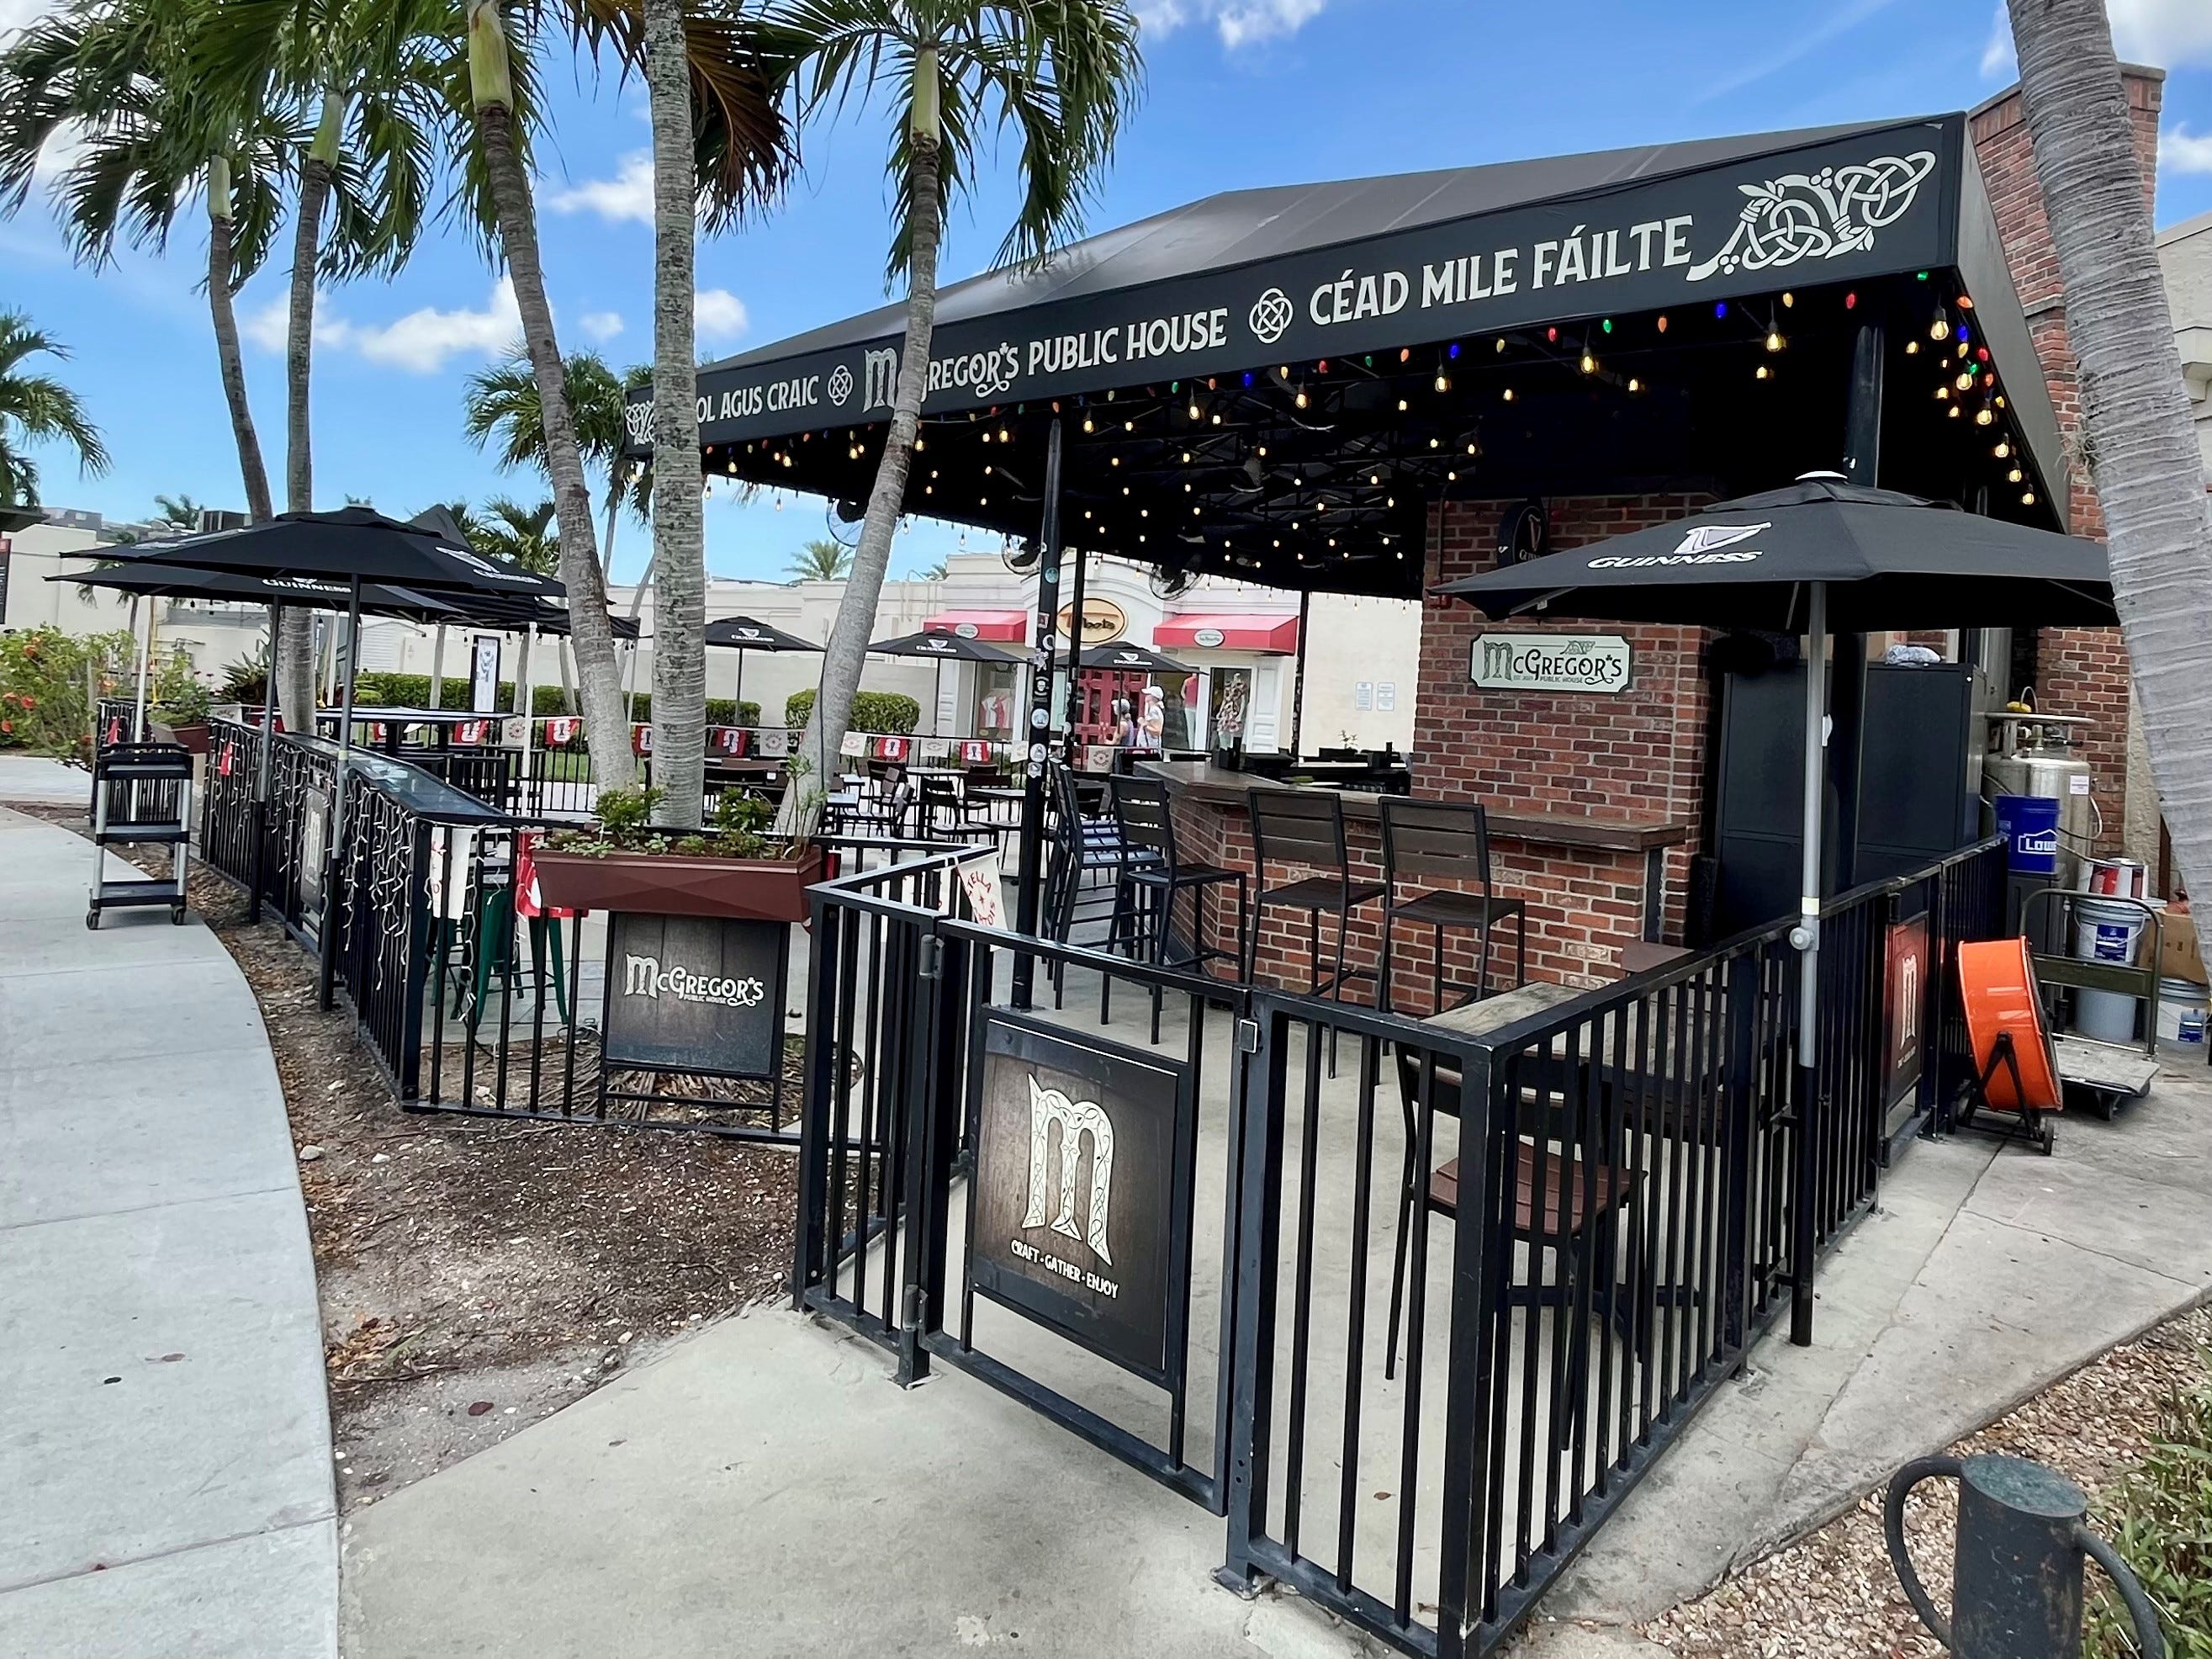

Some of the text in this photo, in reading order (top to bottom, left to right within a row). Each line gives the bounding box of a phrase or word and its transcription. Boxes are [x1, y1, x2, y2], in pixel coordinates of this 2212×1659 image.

[1310, 215, 1694, 326] CÉAD MILE FÁILTE
[1028, 327, 1119, 376] PUBLIC
[1126, 308, 1228, 360] HOUSE
[696, 375, 819, 423] OL AGUS CRAIC
[1587, 551, 1763, 569] GUINNESS
[1011, 1239, 1119, 1299] CRAFT GATHER ENJOY
